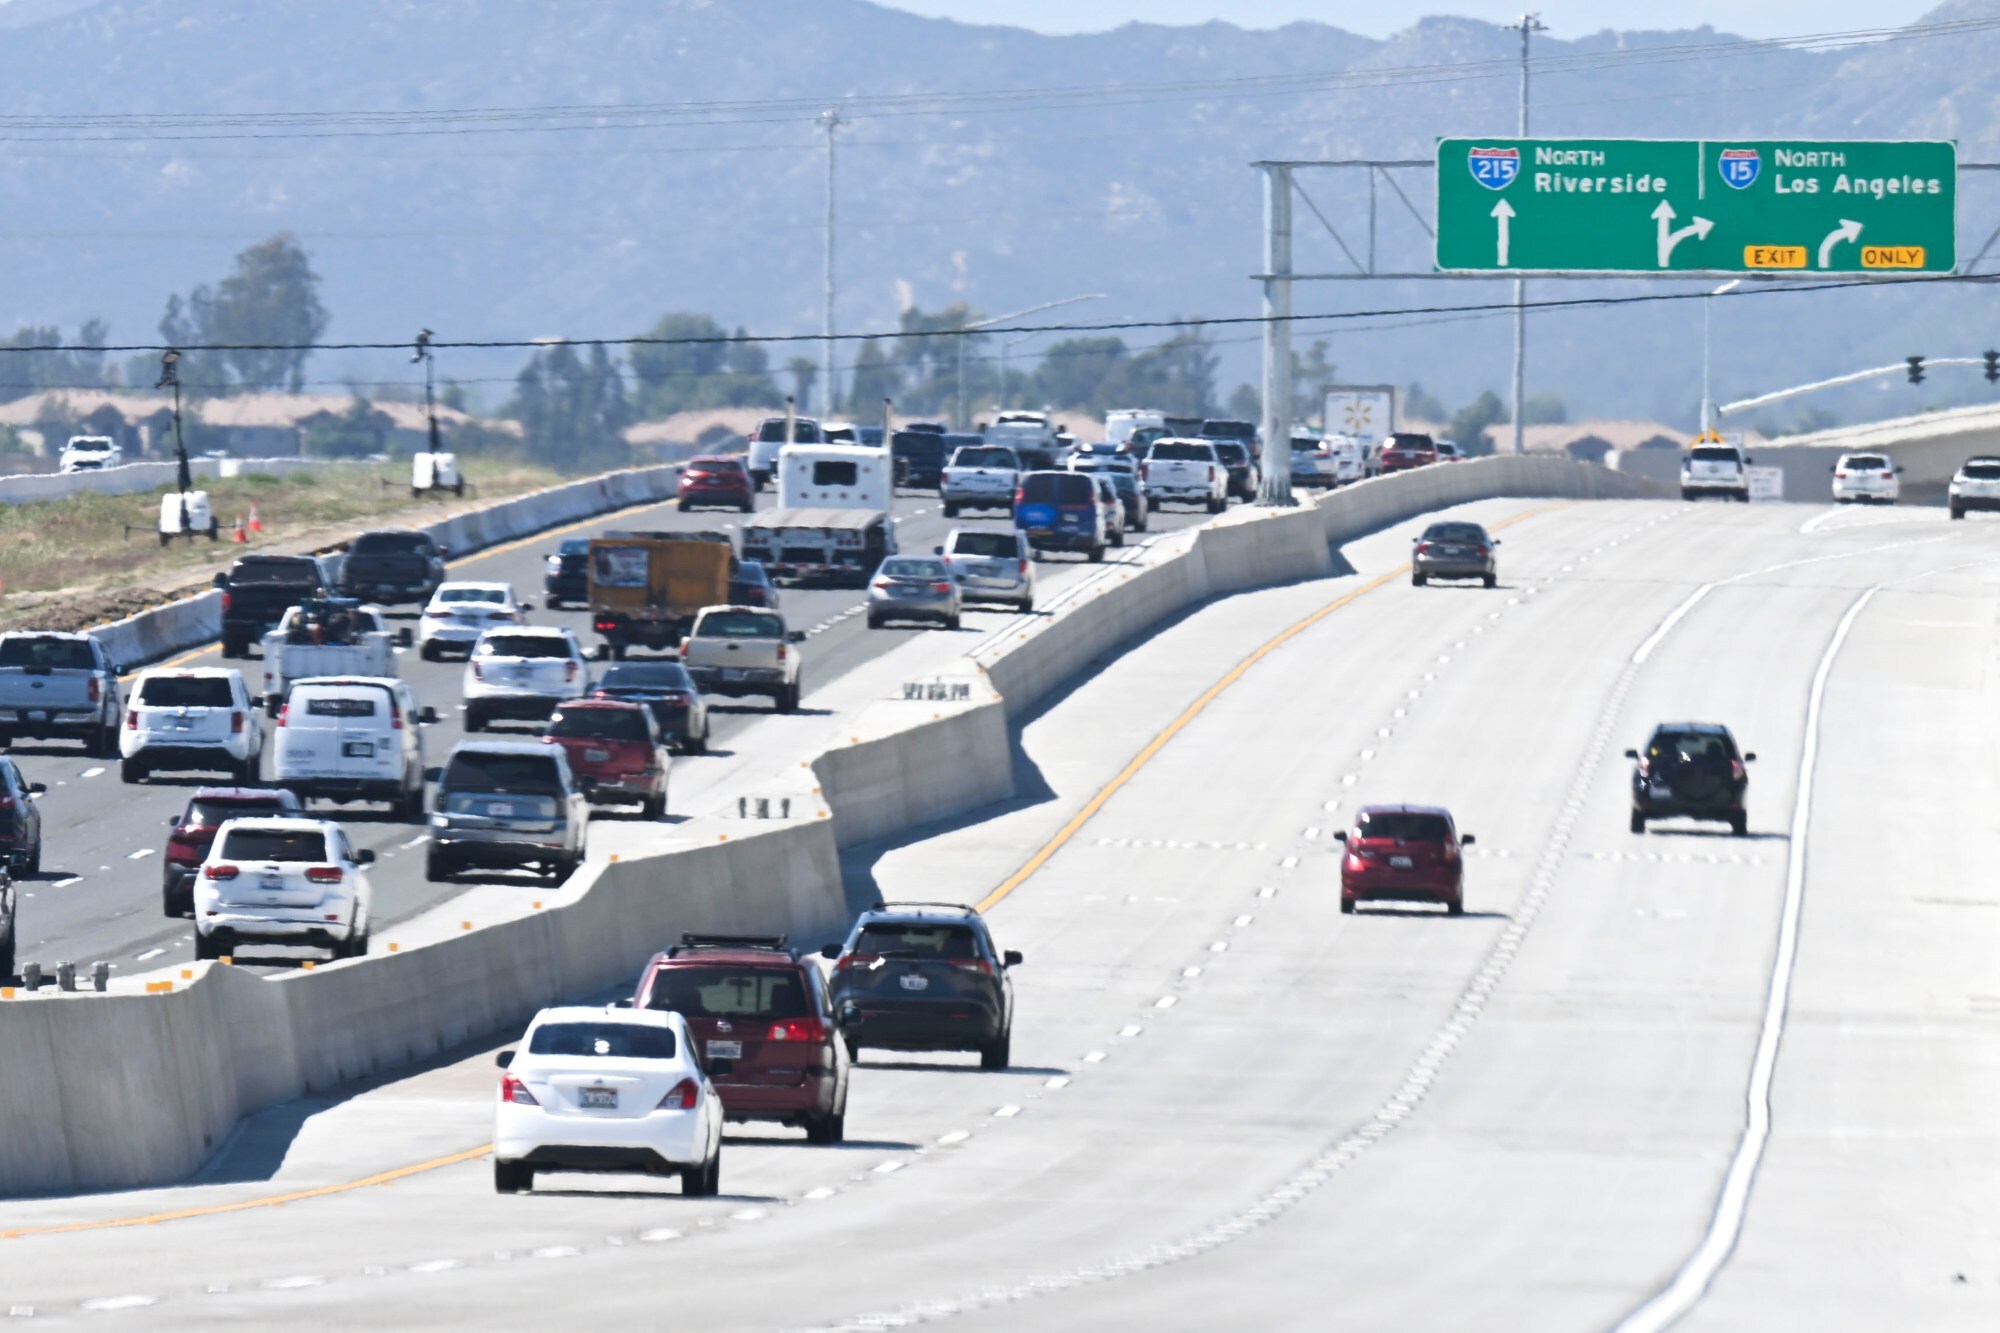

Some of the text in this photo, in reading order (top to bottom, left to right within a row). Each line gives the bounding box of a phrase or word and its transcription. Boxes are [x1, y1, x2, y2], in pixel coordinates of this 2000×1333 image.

[1535, 147, 1605, 166] NORTH
[1774, 149, 1846, 167] NORTH
[1477, 160, 1514, 179] 215
[1730, 161, 1753, 181] 15
[1535, 172, 1667, 193] Riverside
[1775, 173, 1941, 200] Los Angeles
[1754, 249, 1920, 264] EXIT ONLY
